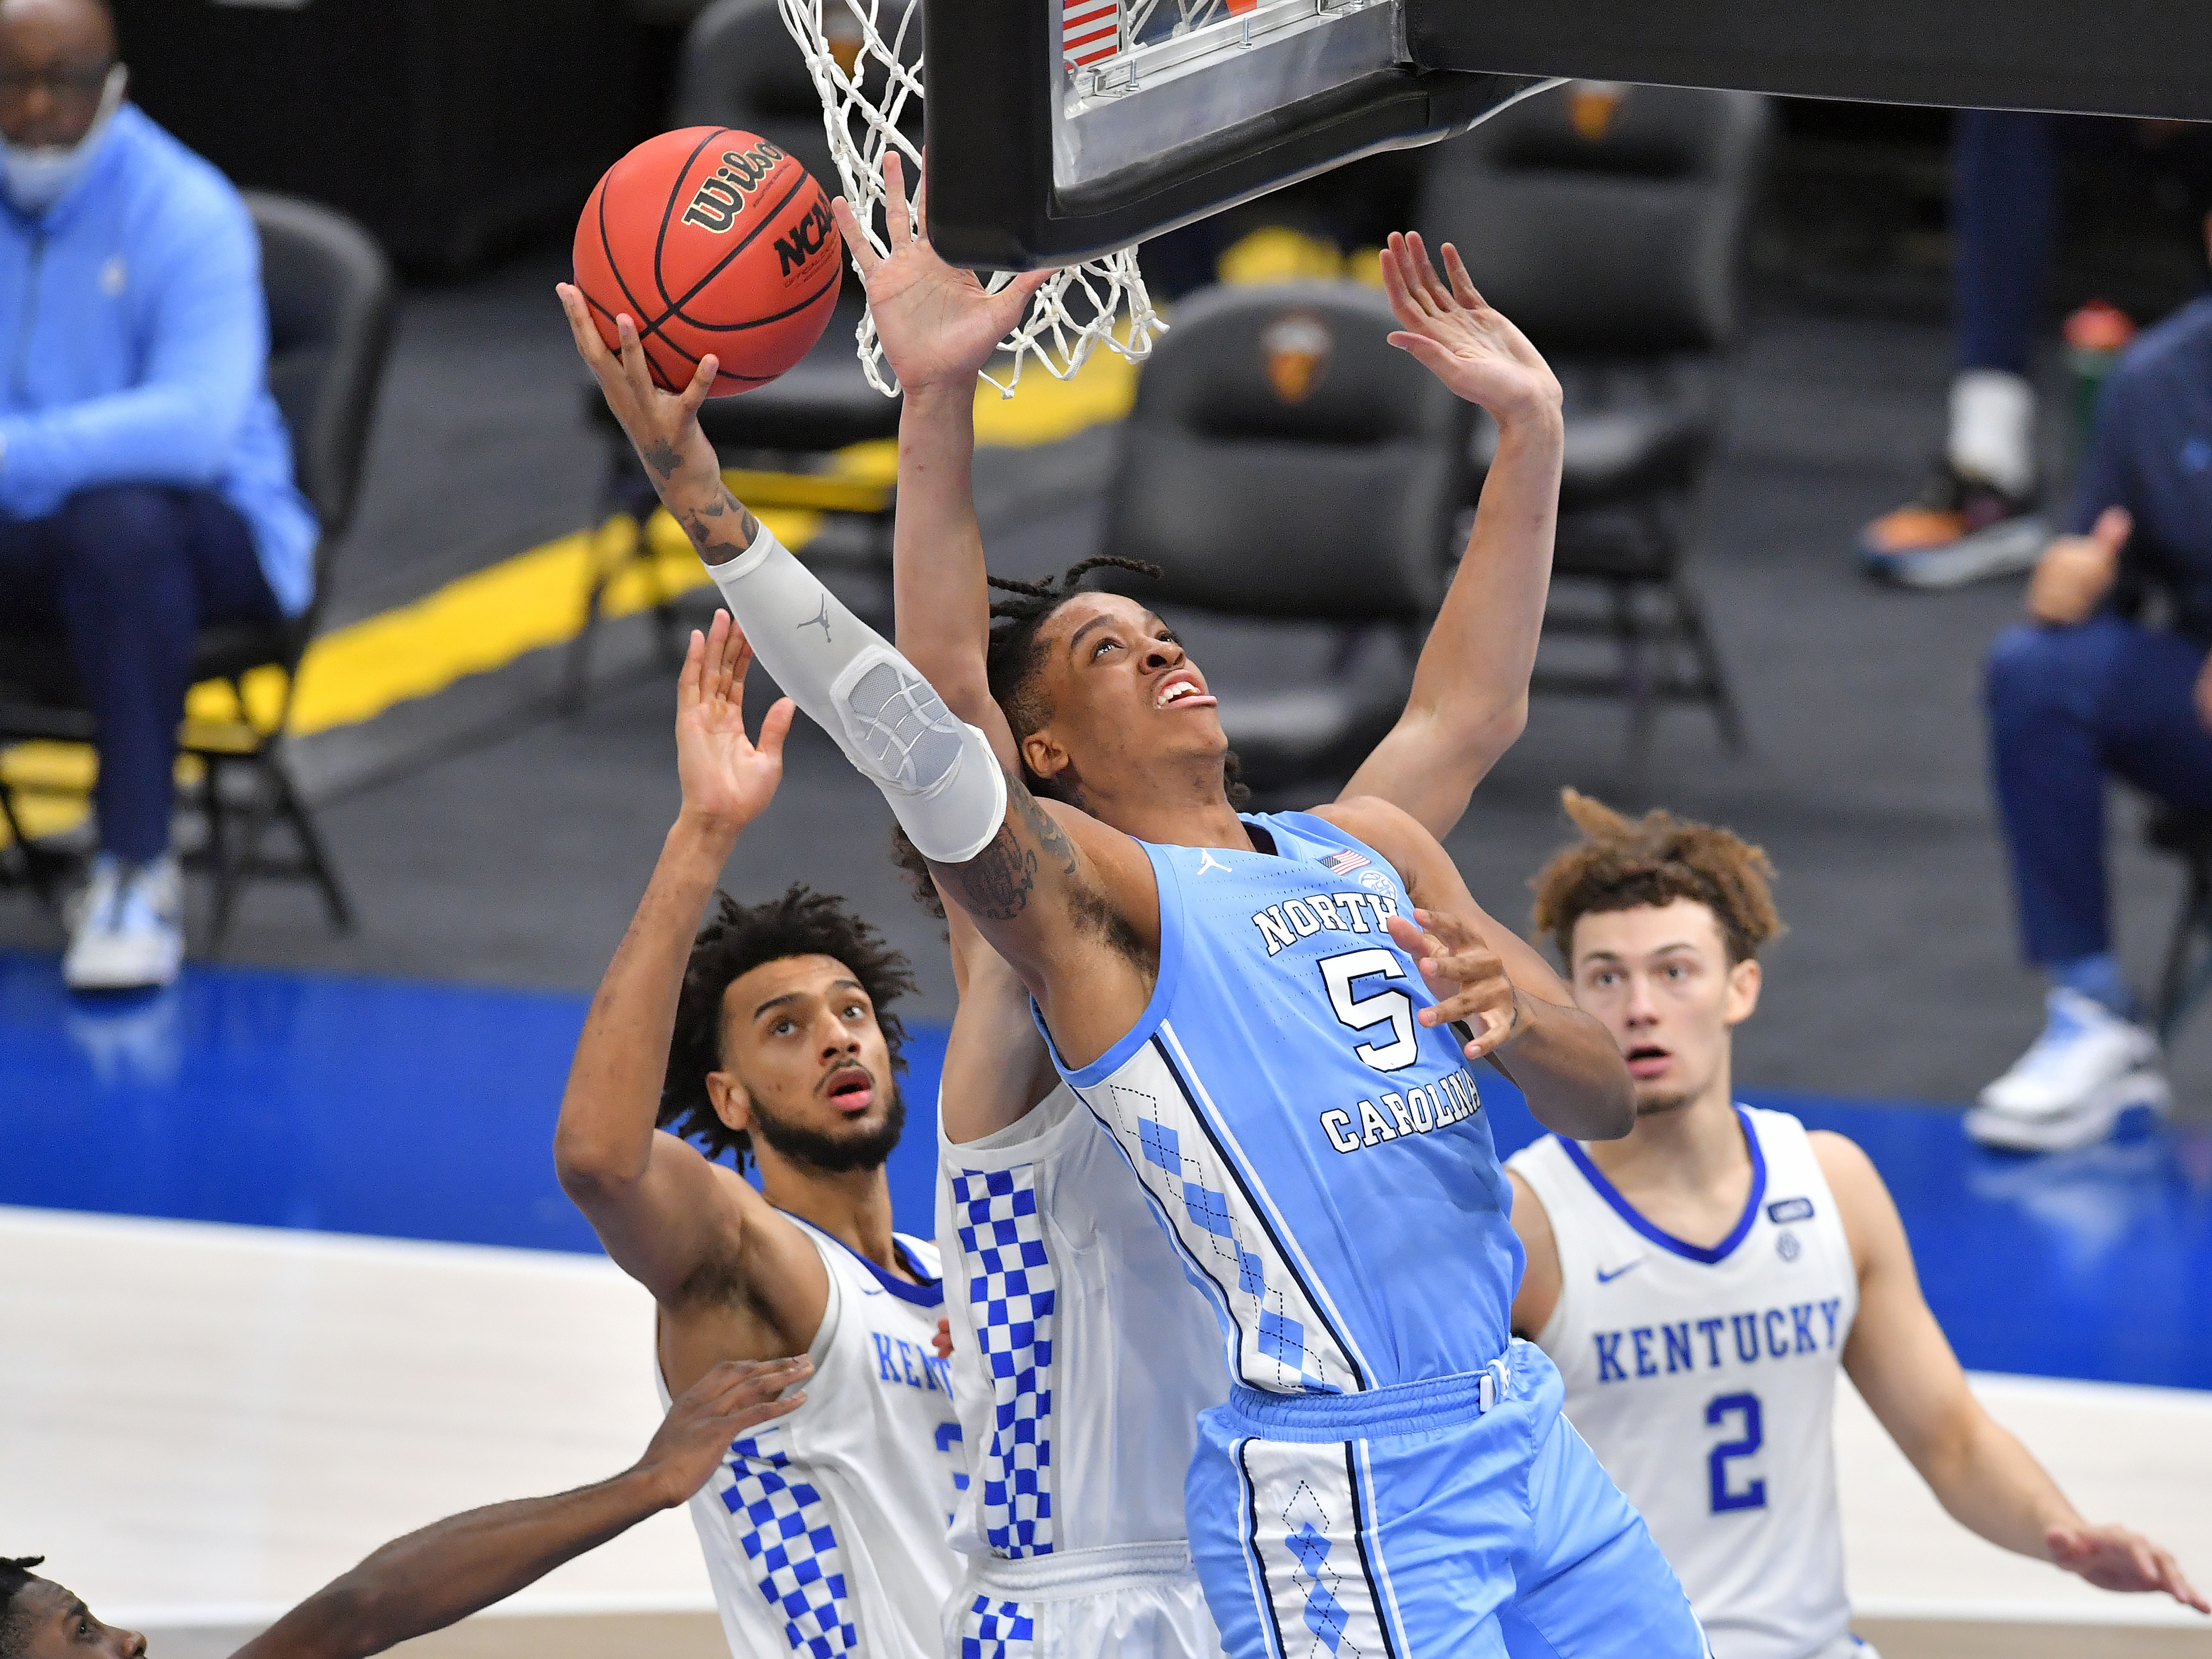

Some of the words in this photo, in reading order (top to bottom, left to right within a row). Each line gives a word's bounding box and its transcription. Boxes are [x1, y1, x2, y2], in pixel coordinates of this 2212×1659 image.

[1253, 892, 1399, 957] NORTH
[1317, 947, 1418, 1073] 5
[1320, 1066, 1481, 1155] CAROLINA
[1593, 1297, 1841, 1384] KENTUCKY
[1704, 1391, 1766, 1515] 2
